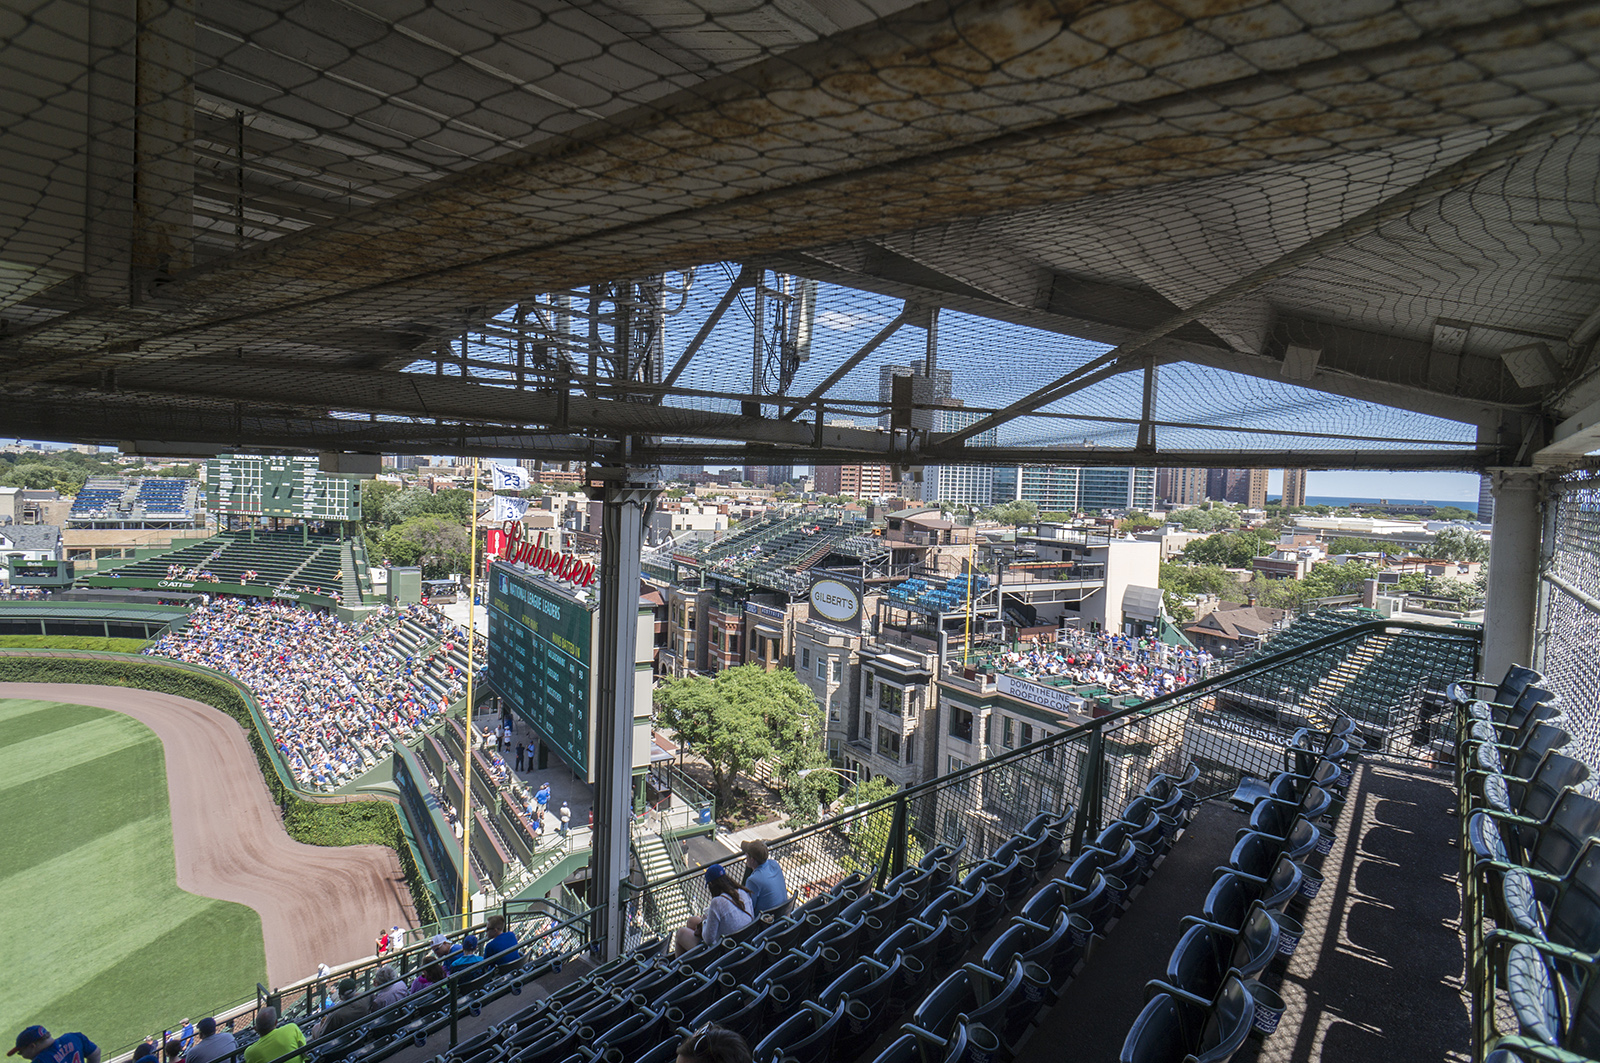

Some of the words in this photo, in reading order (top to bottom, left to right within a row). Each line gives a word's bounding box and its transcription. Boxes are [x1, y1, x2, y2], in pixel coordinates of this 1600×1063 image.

[504, 474, 520, 487] 23
[503, 519, 596, 588] Budweiser
[509, 582, 527, 603] NATIONAL
[526, 591, 541, 611] LEAGUE
[542, 599, 561, 621] LEADERS
[814, 591, 855, 610] GILBERT'S
[1009, 687, 1070, 713] ROOFTOP.COM
